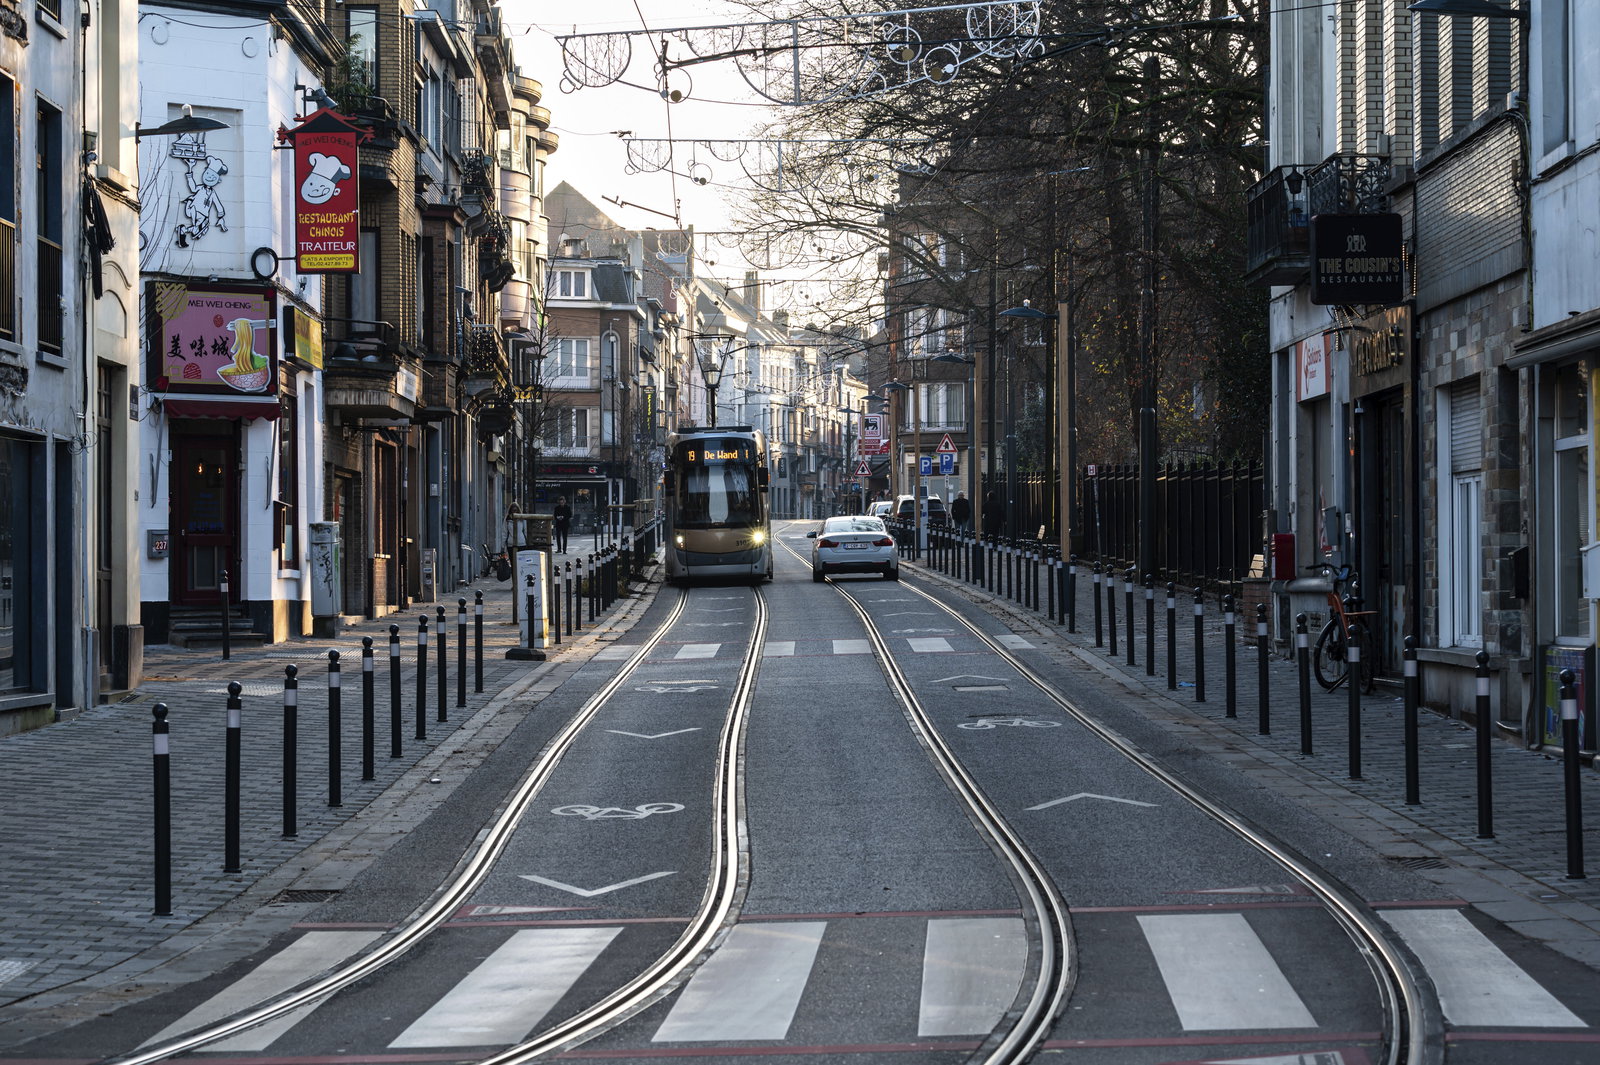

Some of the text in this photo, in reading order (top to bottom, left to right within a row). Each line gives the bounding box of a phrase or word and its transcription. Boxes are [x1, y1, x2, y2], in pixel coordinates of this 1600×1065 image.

[313, 136, 329, 144] WEI
[298, 212, 355, 224] RESTAURANT
[309, 226, 345, 237] CHINOIS
[299, 241, 356, 252] TRAITEUR
[1319, 257, 1400, 274] THE COUSIN'S
[1321, 275, 1399, 284] RESTAURANT
[188, 300, 252, 310] MEI WEI CHENG
[167, 333, 233, 361] 美味城
[687, 450, 696, 462] 19
[704, 450, 715, 460] De
[716, 450, 738, 460] Wand
[943, 455, 951, 466] P
[921, 460, 931, 473] P
[155, 541, 167, 550] 237
